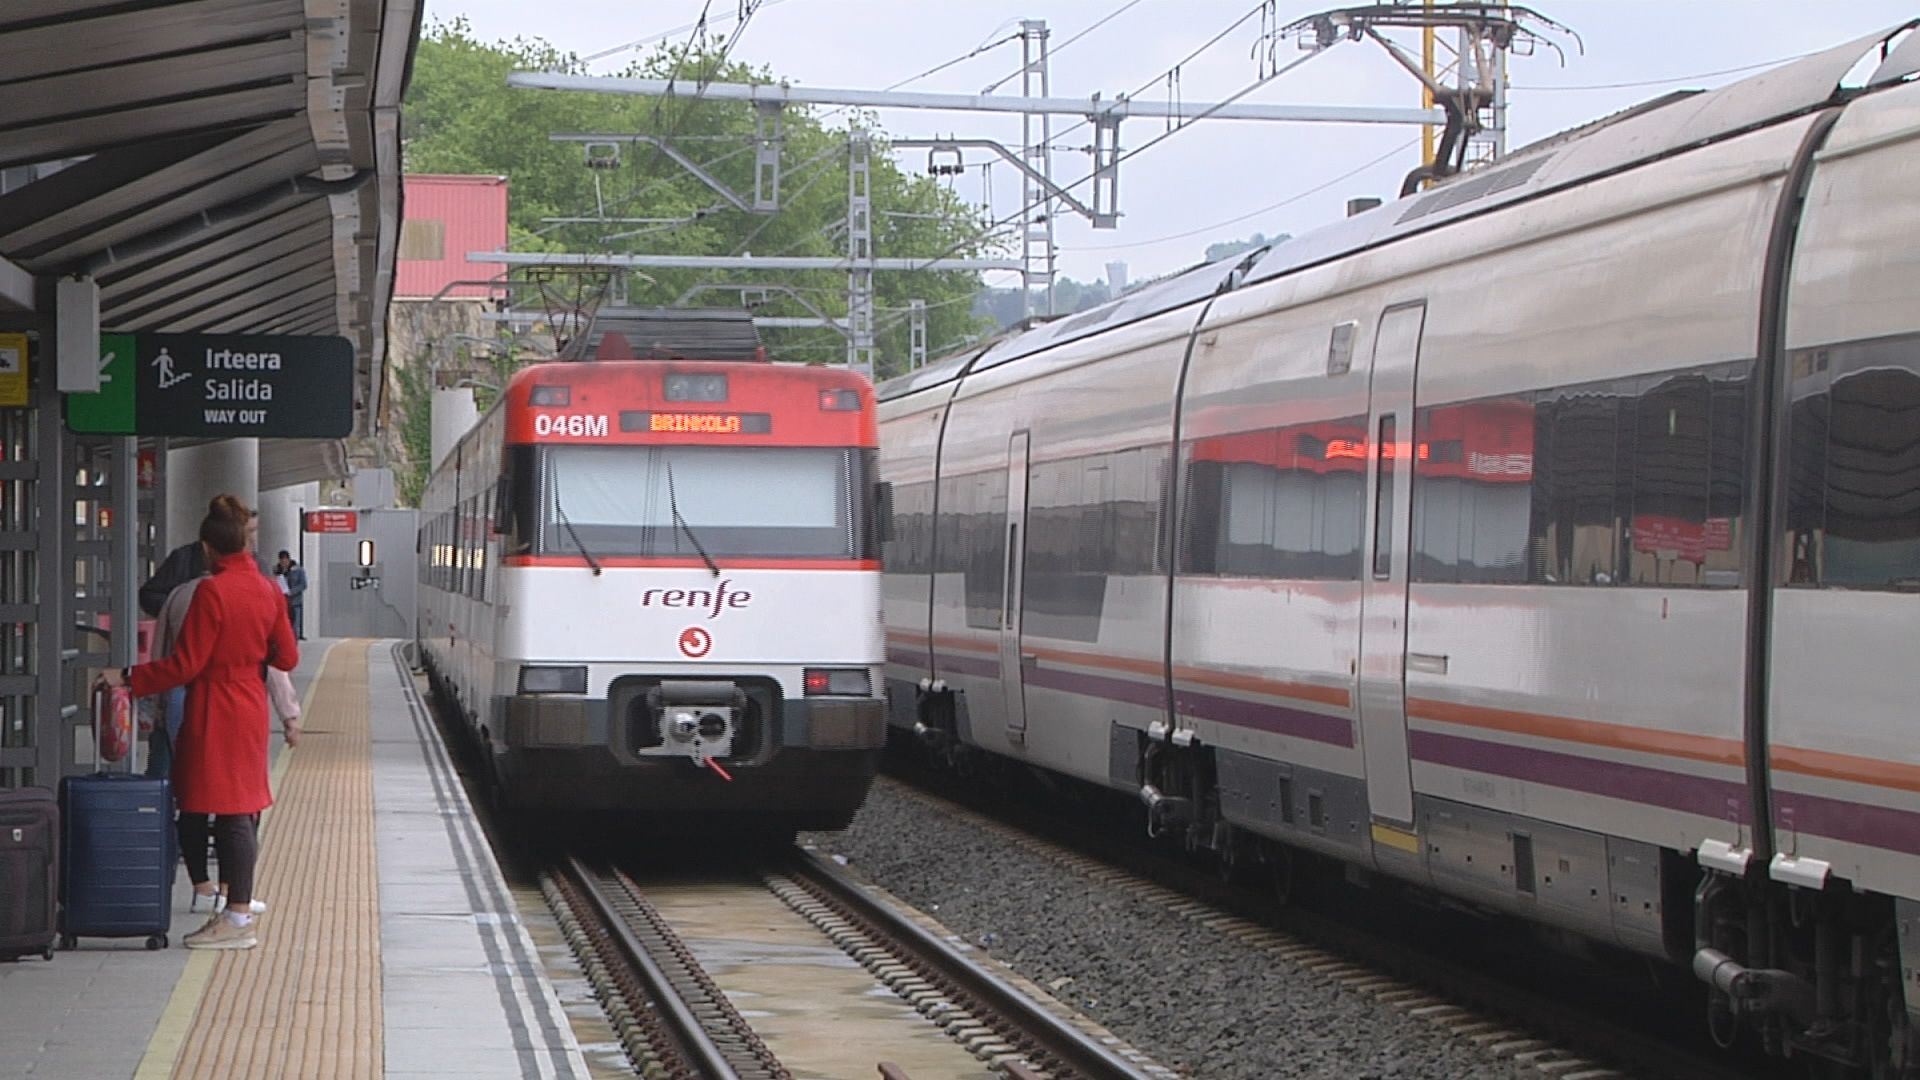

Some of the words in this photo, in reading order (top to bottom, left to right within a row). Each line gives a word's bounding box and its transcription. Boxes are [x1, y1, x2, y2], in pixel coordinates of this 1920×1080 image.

[206, 348, 281, 369] Irteera
[205, 379, 273, 400] Salida
[204, 409, 236, 423] WAY
[239, 409, 267, 424] OUT
[535, 415, 609, 436] 046M
[642, 579, 752, 619] renfe
